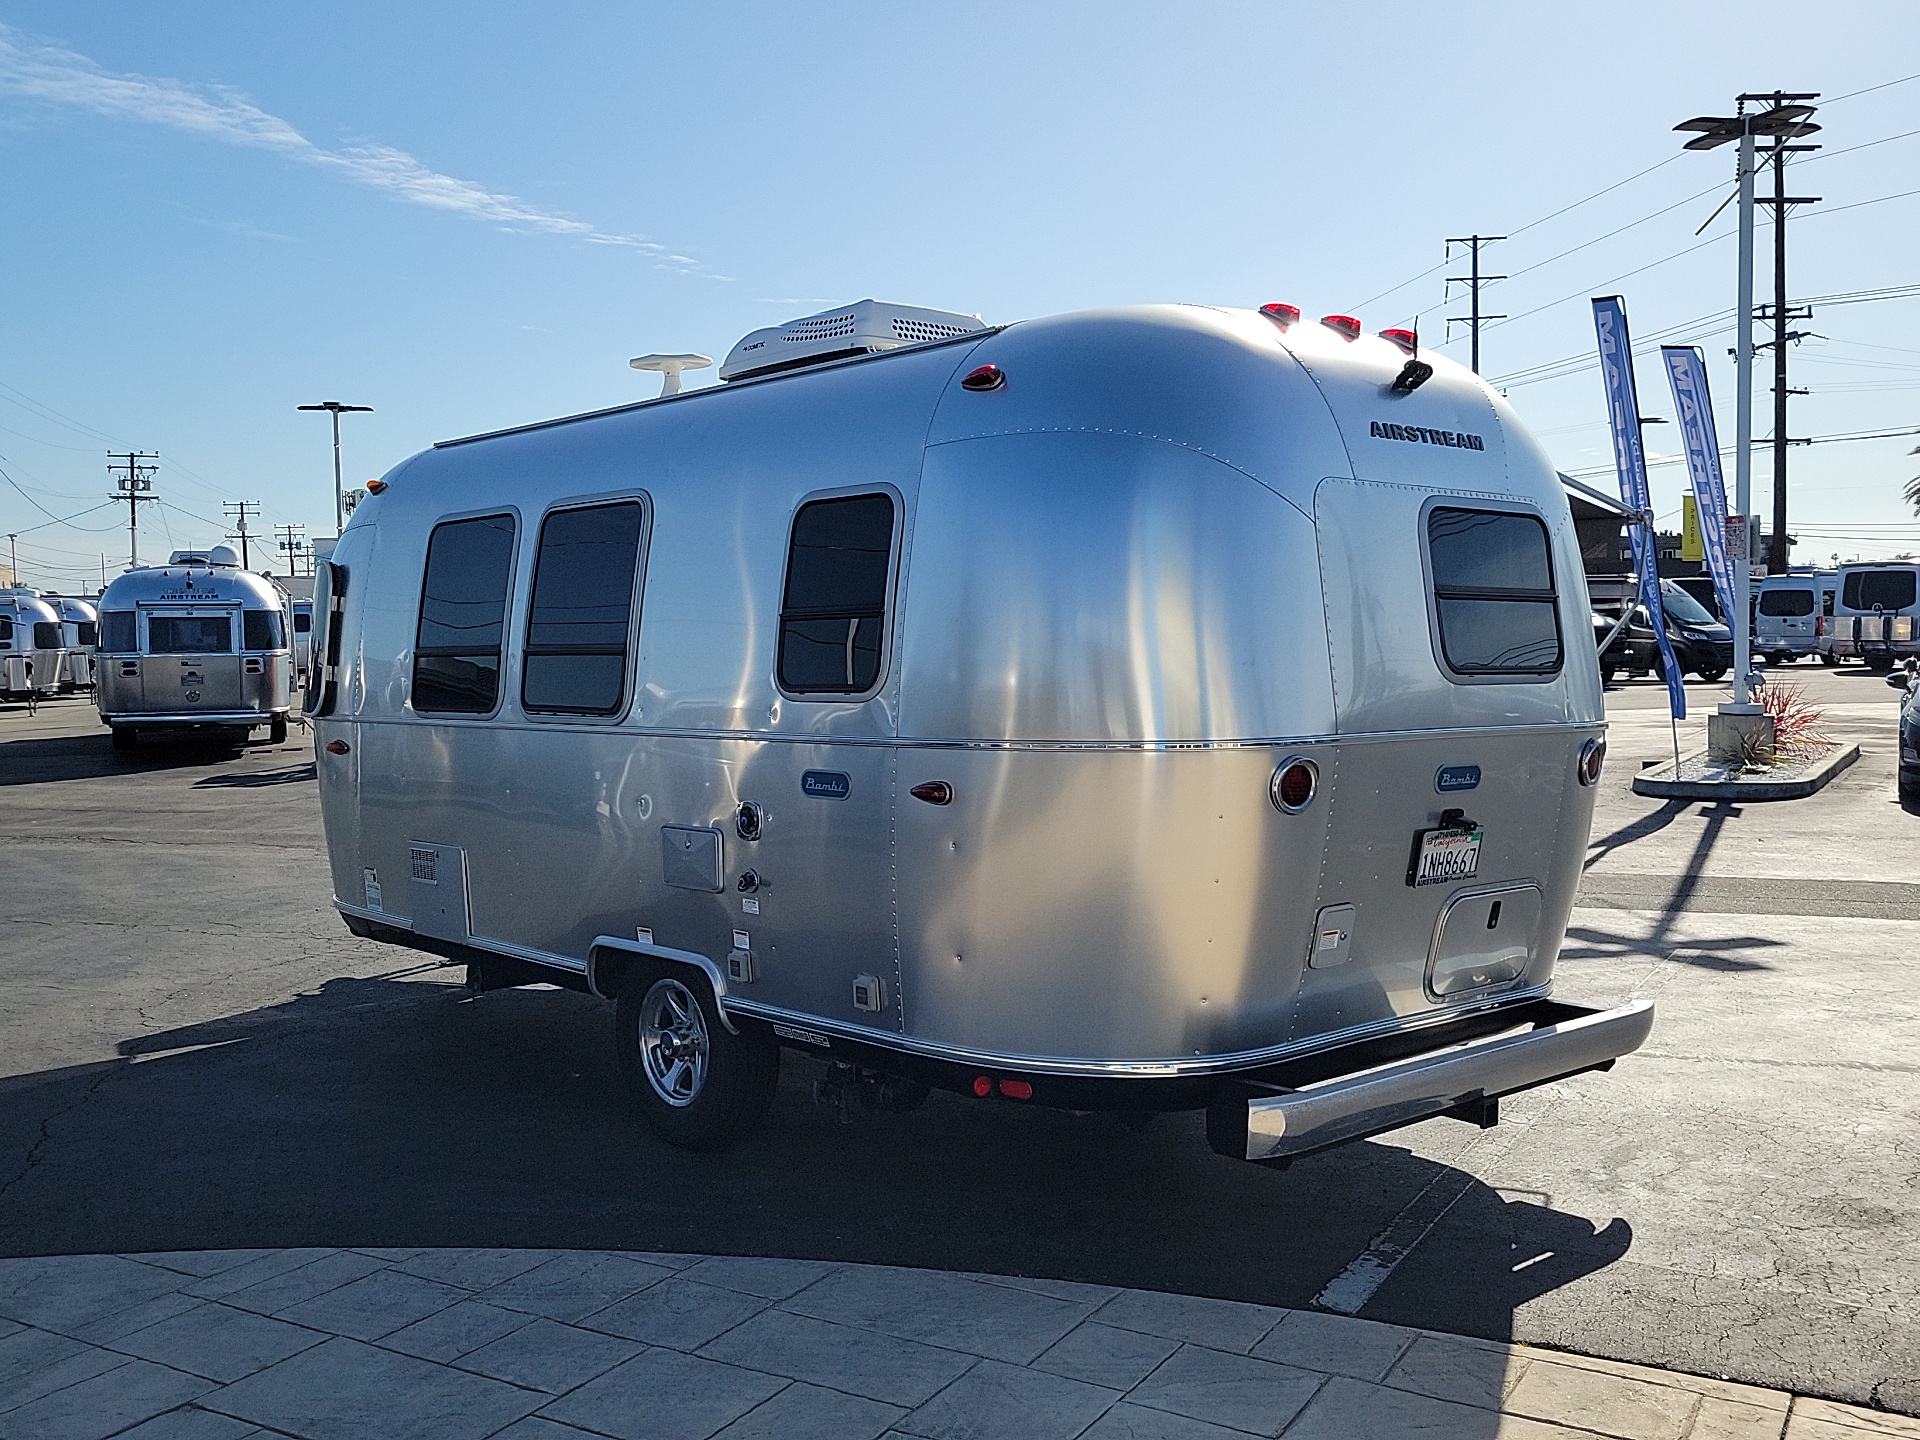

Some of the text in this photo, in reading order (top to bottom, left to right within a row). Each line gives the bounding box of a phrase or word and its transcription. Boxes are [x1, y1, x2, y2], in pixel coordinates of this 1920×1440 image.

[1370, 420, 1485, 451] AIRSTREAM
[805, 777, 846, 792] Bambi
[1440, 773, 1477, 786] Bambi
[1420, 848, 1477, 879] 1NH8667
[1416, 876, 1449, 887] AIRSTREAM
